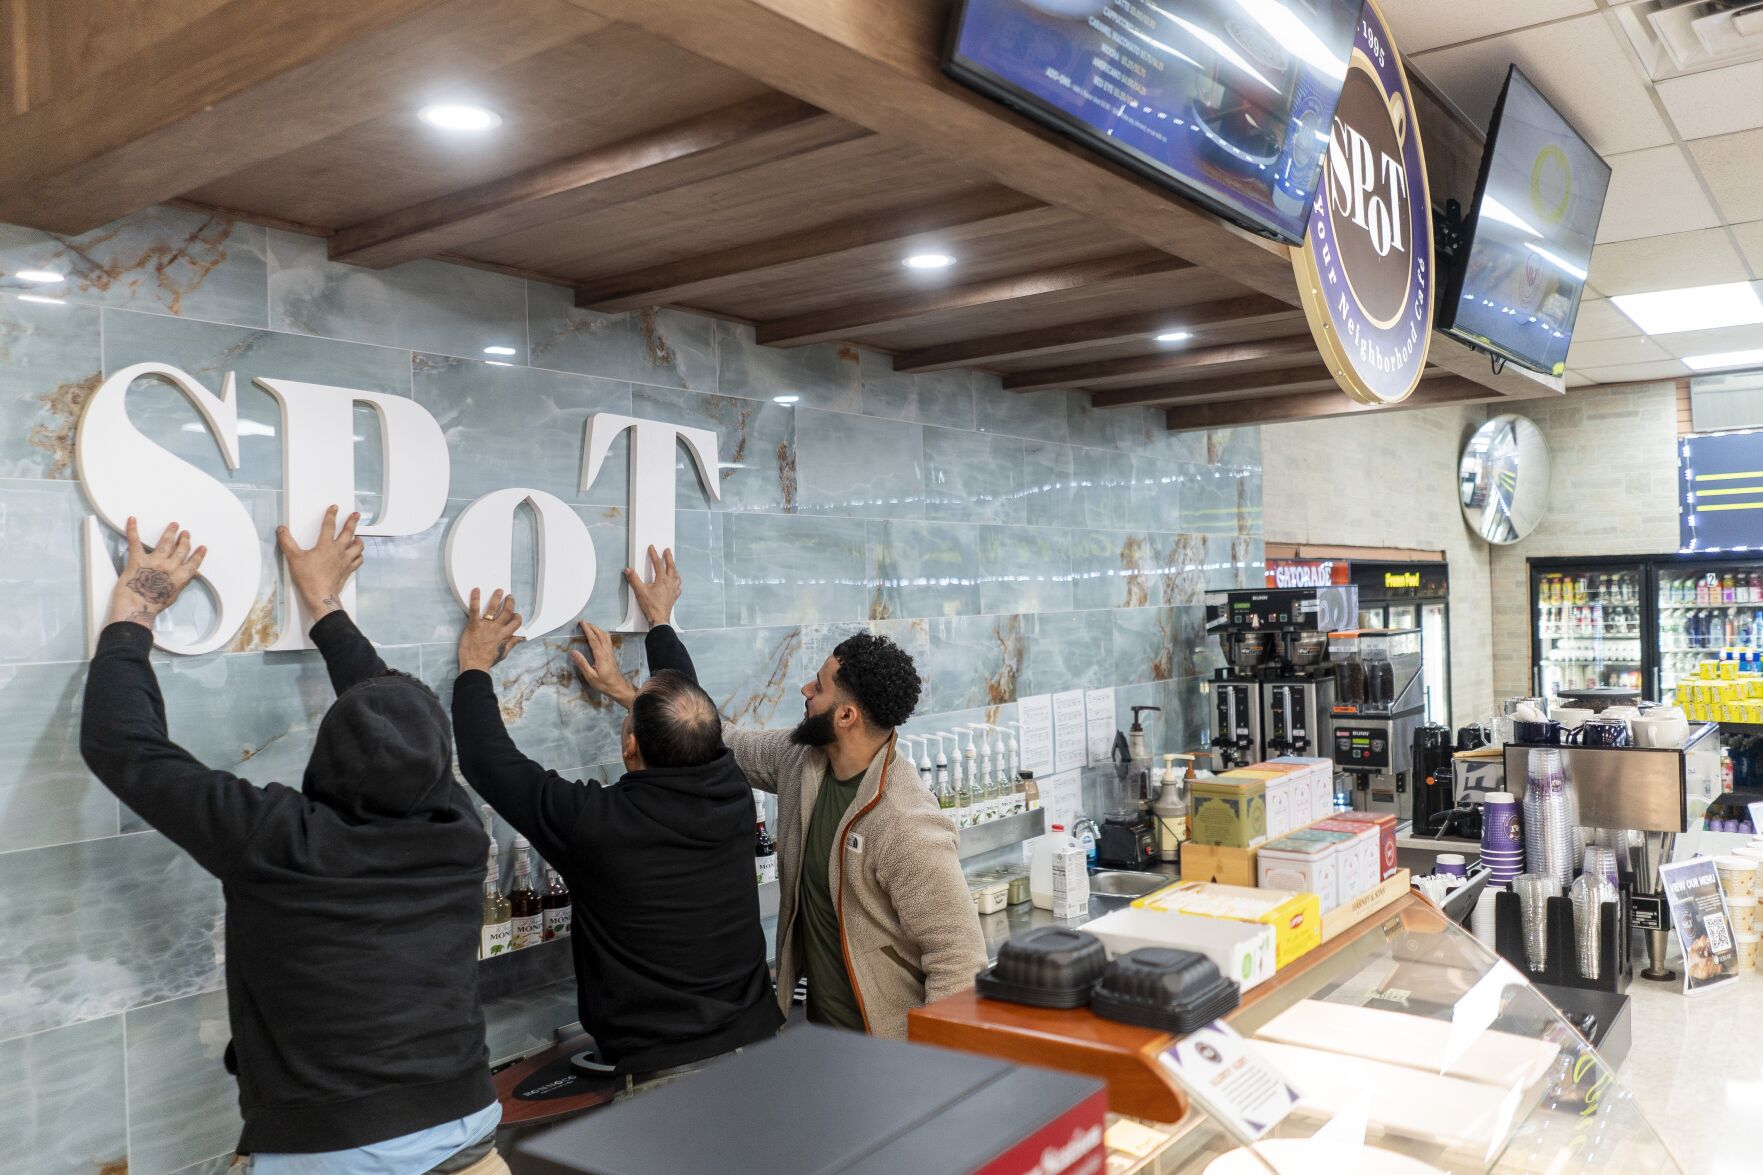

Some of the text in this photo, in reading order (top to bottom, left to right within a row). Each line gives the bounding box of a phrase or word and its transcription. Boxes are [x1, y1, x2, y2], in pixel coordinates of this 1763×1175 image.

[1362, 20, 1385, 68] 1995
[1313, 195, 1337, 285] Your
[1338, 292, 1418, 373] Neighborhood
[1276, 566, 1332, 588] GATORADE
